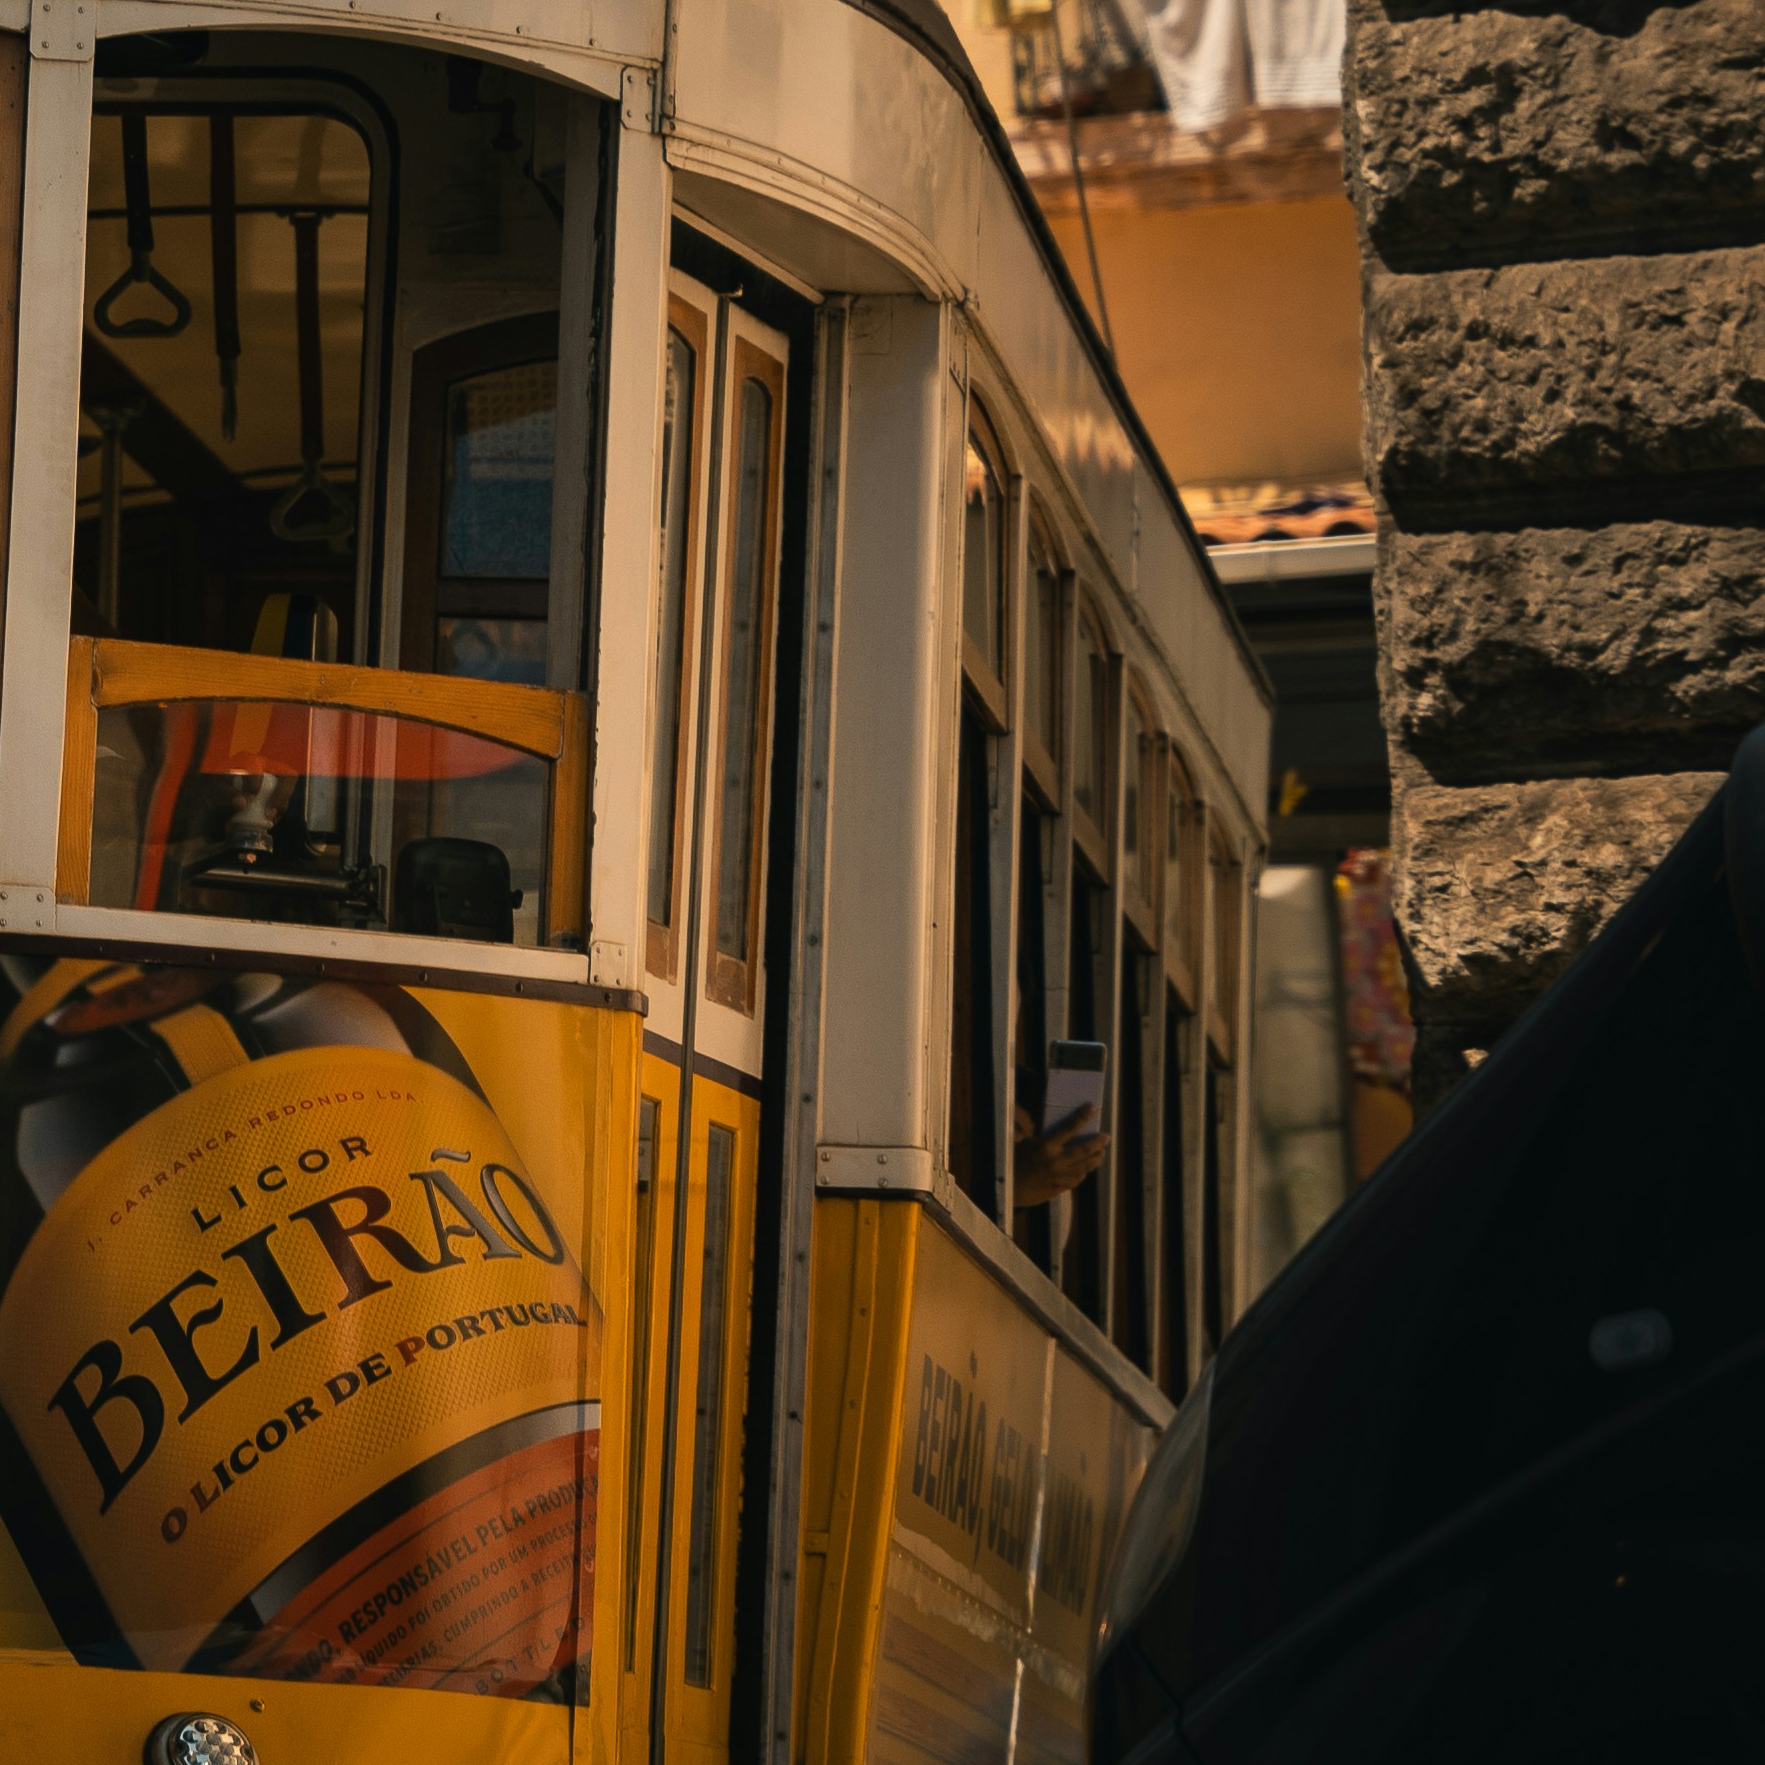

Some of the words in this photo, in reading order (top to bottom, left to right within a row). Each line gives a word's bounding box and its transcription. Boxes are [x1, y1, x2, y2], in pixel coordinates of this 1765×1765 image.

[108, 1128, 237, 1227] CARRANCA
[248, 1090, 365, 1130] REDONDO
[190, 1135, 373, 1235] LICOR
[46, 1147, 566, 1517] BEIRÃO
[159, 1506, 189, 1544] O
[189, 1396, 323, 1516] LICOR
[324, 1352, 393, 1409] DE
[392, 1301, 589, 1371] PORTUGAL
[338, 1534, 480, 1645] RESPONSÁVEL
[476, 1506, 526, 1548] PELA
[409, 1608, 432, 1630] FOI
[434, 1573, 481, 1613] OBTIDO
[483, 1556, 507, 1579] POR
